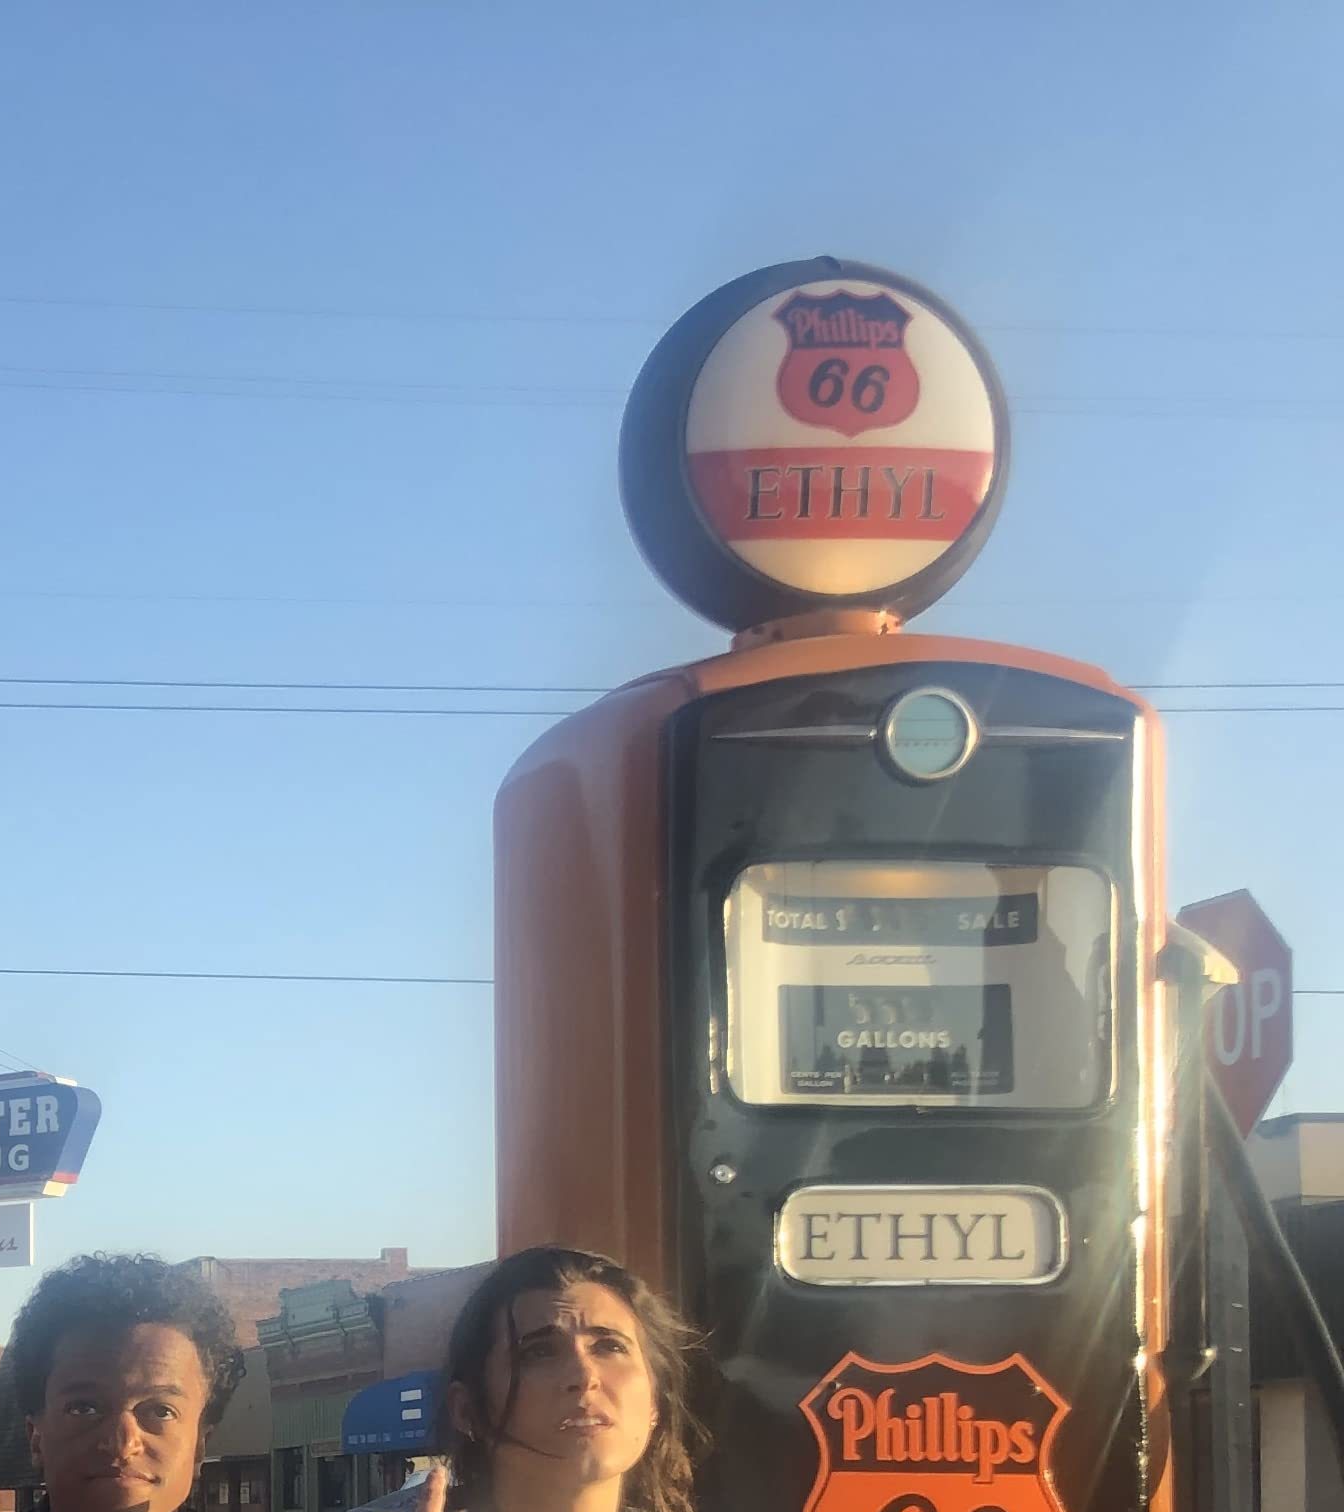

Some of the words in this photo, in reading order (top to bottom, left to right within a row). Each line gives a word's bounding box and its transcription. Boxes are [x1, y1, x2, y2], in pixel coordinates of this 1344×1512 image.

[785, 306, 899, 348] Phillips
[808, 357, 892, 415] 66
[744, 464, 946, 521] ETHYL
[766, 909, 829, 931] TOTAL
[956, 911, 1020, 931] SALE
[836, 1029, 953, 1049] GALLONS
[799, 1213, 1025, 1263] ETHYL
[827, 1387, 1036, 1483] Phillips
